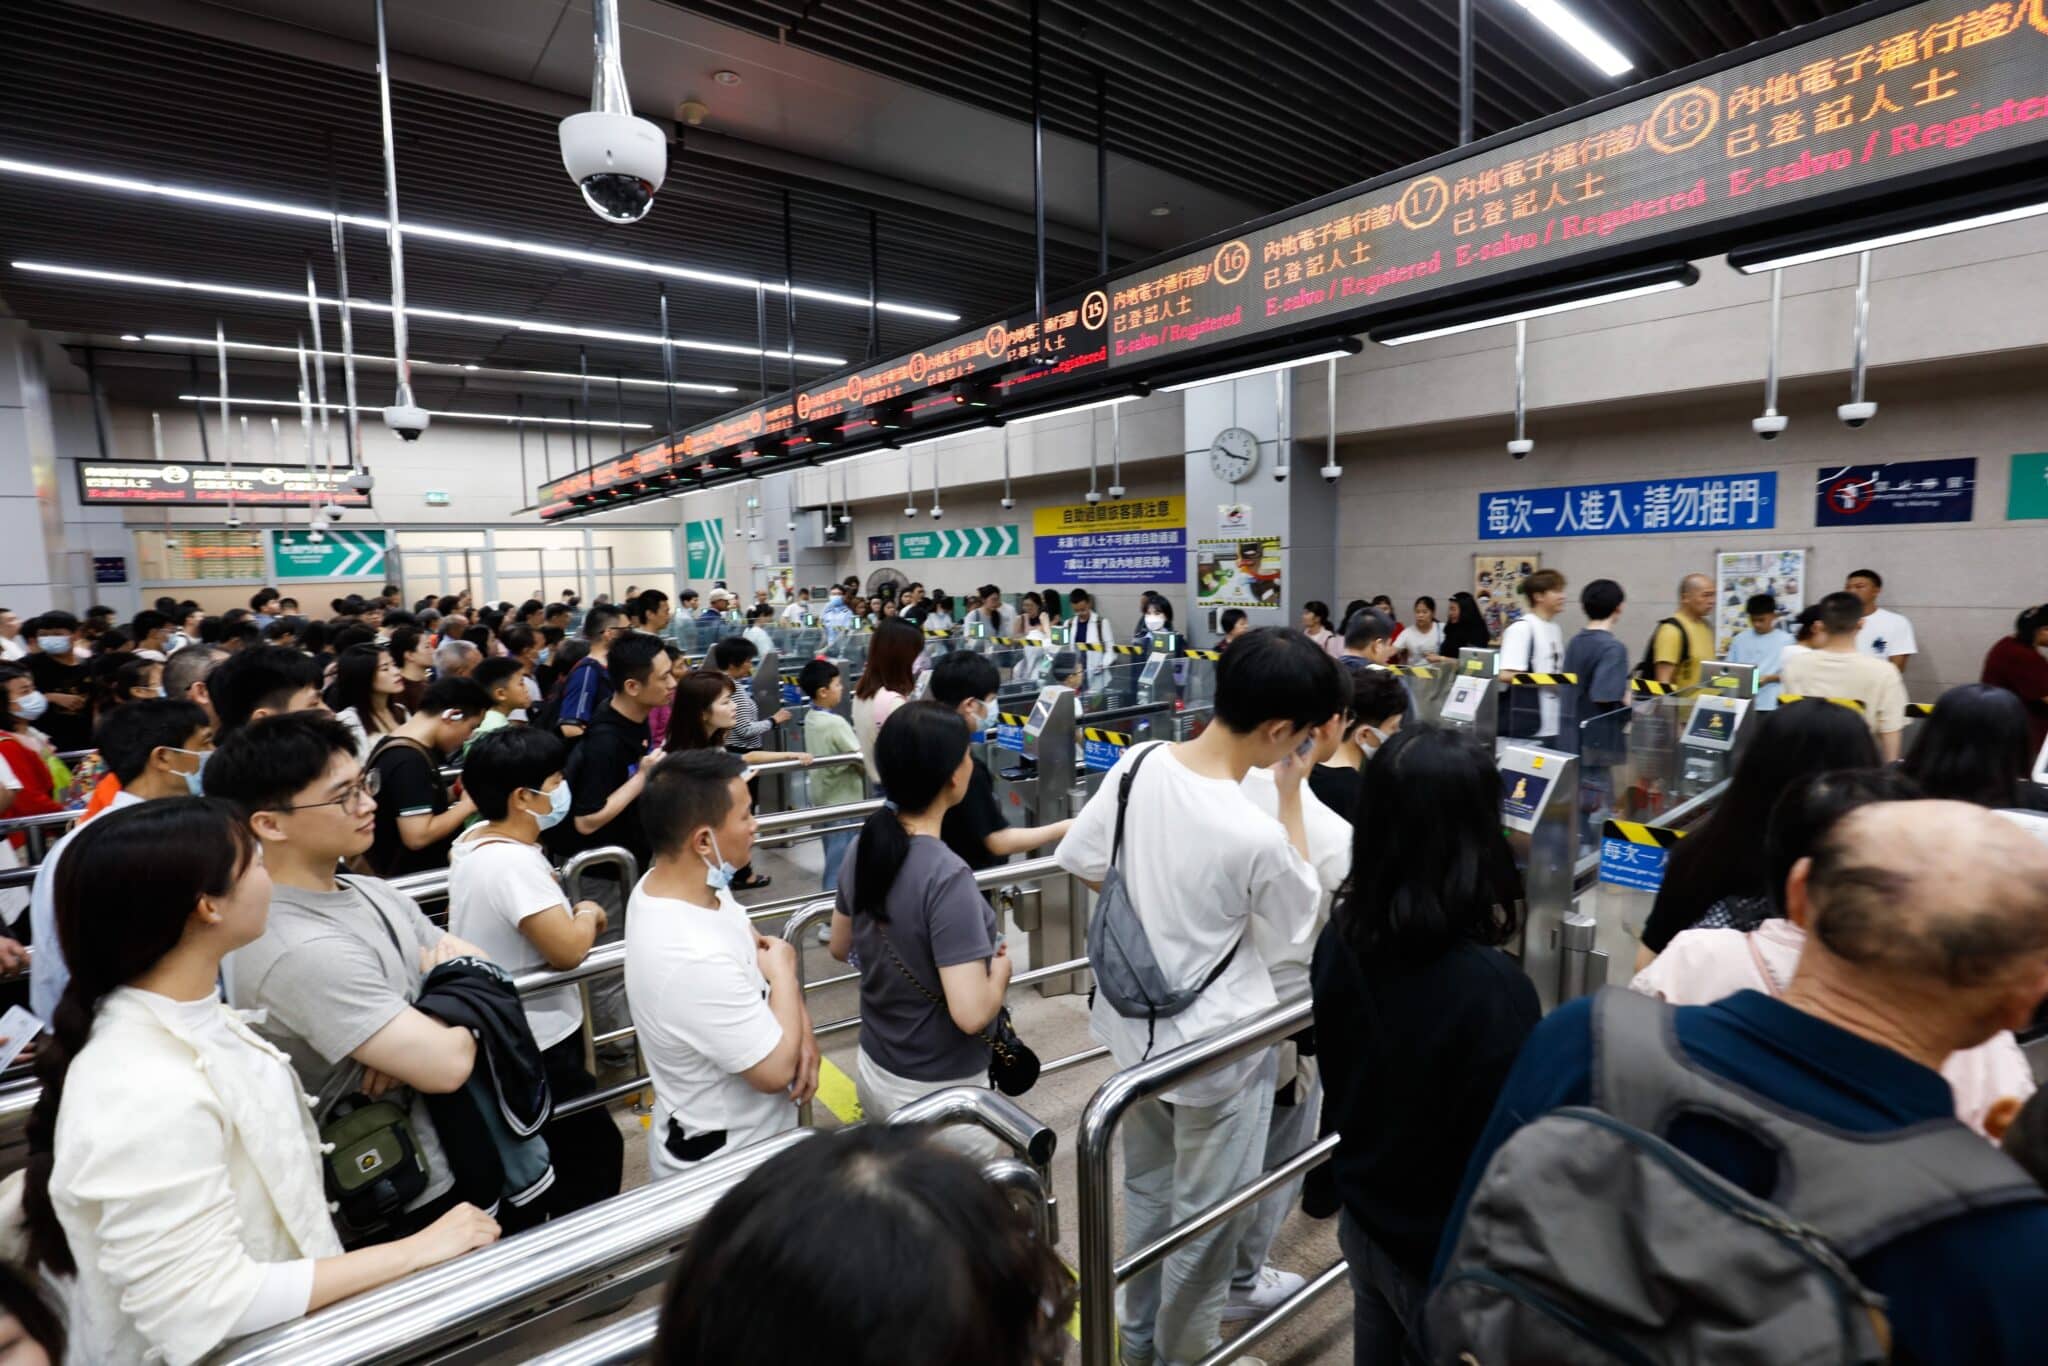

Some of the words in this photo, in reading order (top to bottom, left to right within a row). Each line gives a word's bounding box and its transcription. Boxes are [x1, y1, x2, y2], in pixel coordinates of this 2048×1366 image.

[1664, 97, 1705, 138] 18
[1728, 149, 1852, 198] E-salvo
[1861, 130, 1881, 164] /
[1410, 186, 1442, 216] 17
[1455, 231, 1538, 268] E-salvo
[1543, 217, 1555, 245] /
[1562, 177, 1708, 240] Registered
[1265, 287, 1326, 318] E-salvo
[1329, 277, 1338, 302] /
[1342, 250, 1442, 297] Registered
[1169, 303, 1243, 341] Registered
